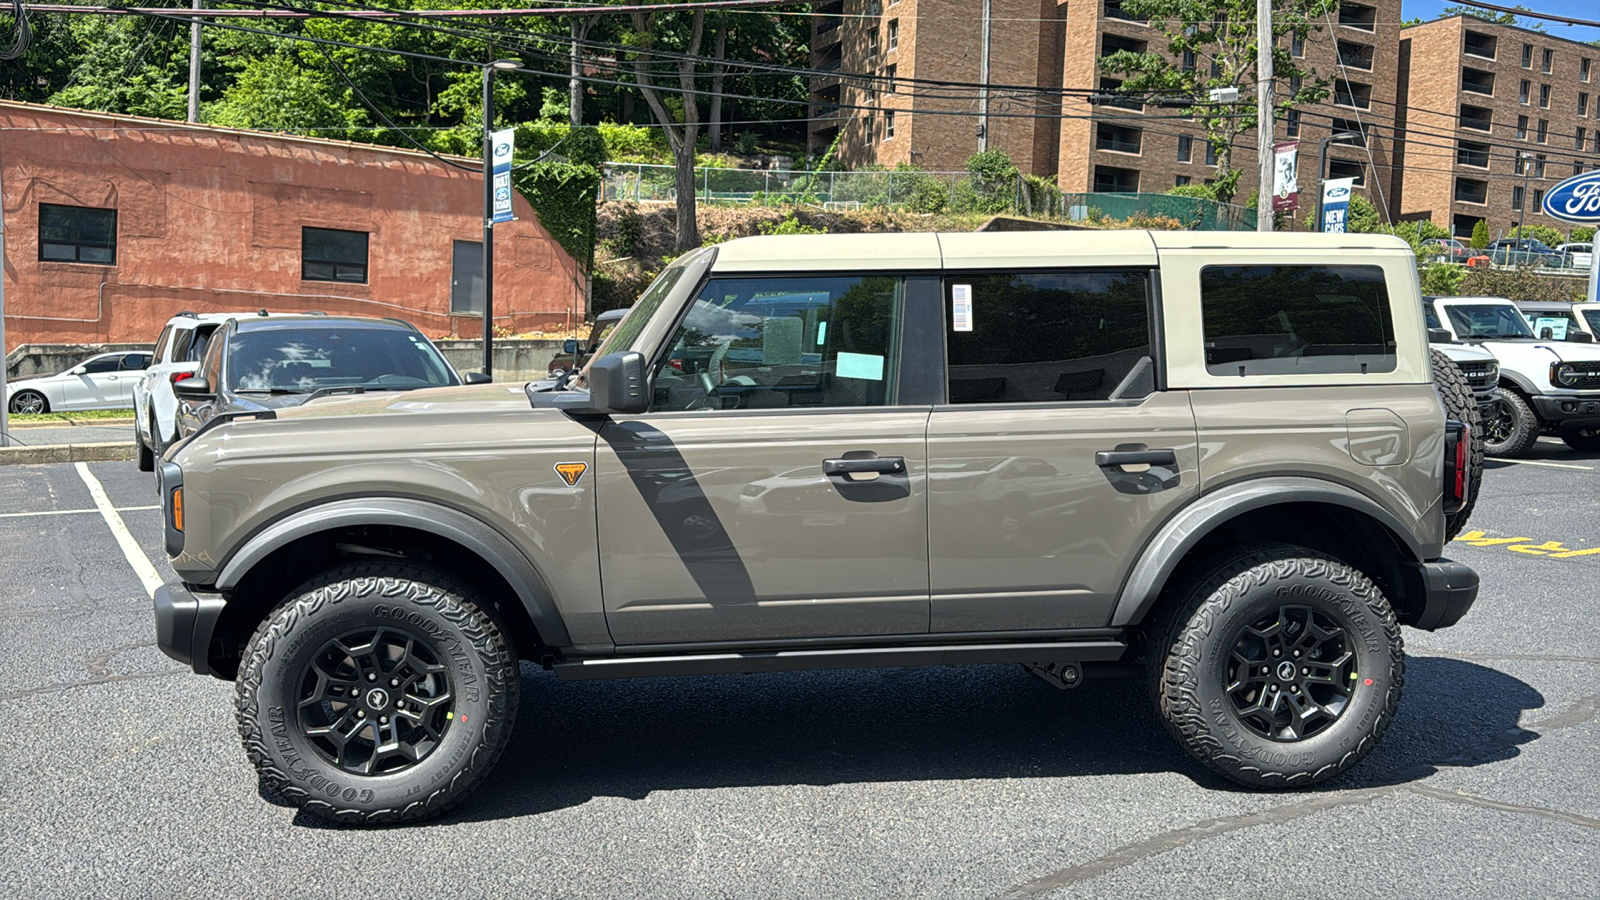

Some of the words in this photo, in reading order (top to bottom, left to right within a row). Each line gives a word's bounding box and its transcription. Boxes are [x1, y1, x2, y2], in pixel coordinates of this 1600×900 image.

[1325, 209, 1345, 224] NEW
[1565, 181, 1600, 214] Fo
[373, 603, 479, 703] GOODYEAR
[1275, 584, 1380, 653] GOODYEAR
[267, 705, 375, 804] GOODYEAR
[430, 728, 474, 784] TERRITORY
[1209, 698, 1315, 768] GOODYEAR
